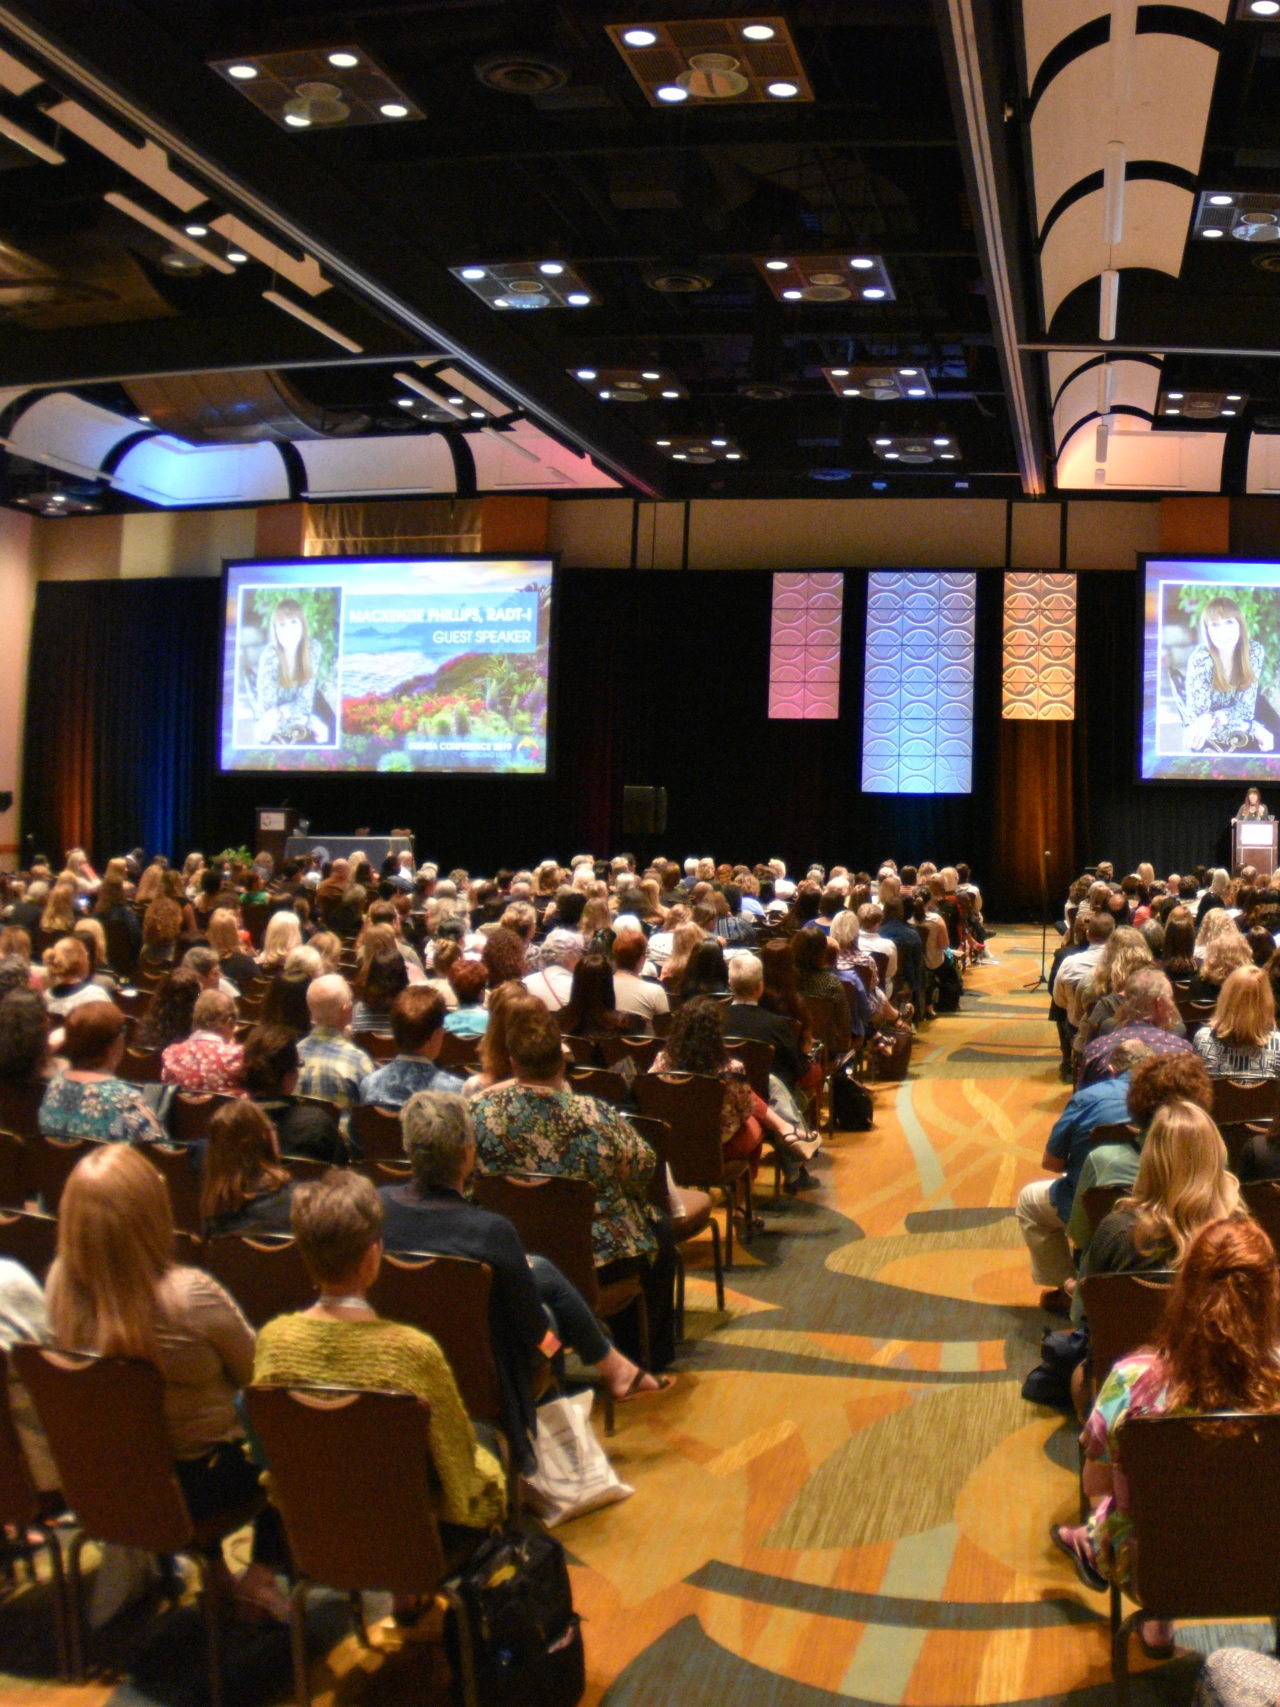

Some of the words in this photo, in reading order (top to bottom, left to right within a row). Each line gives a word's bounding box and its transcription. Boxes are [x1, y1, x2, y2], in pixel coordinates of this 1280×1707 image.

[427, 608, 483, 624] PHILLIPS,
[487, 607, 532, 622] RADT-I
[432, 631, 472, 644] GUEST
[475, 630, 531, 644] SPEAKER
